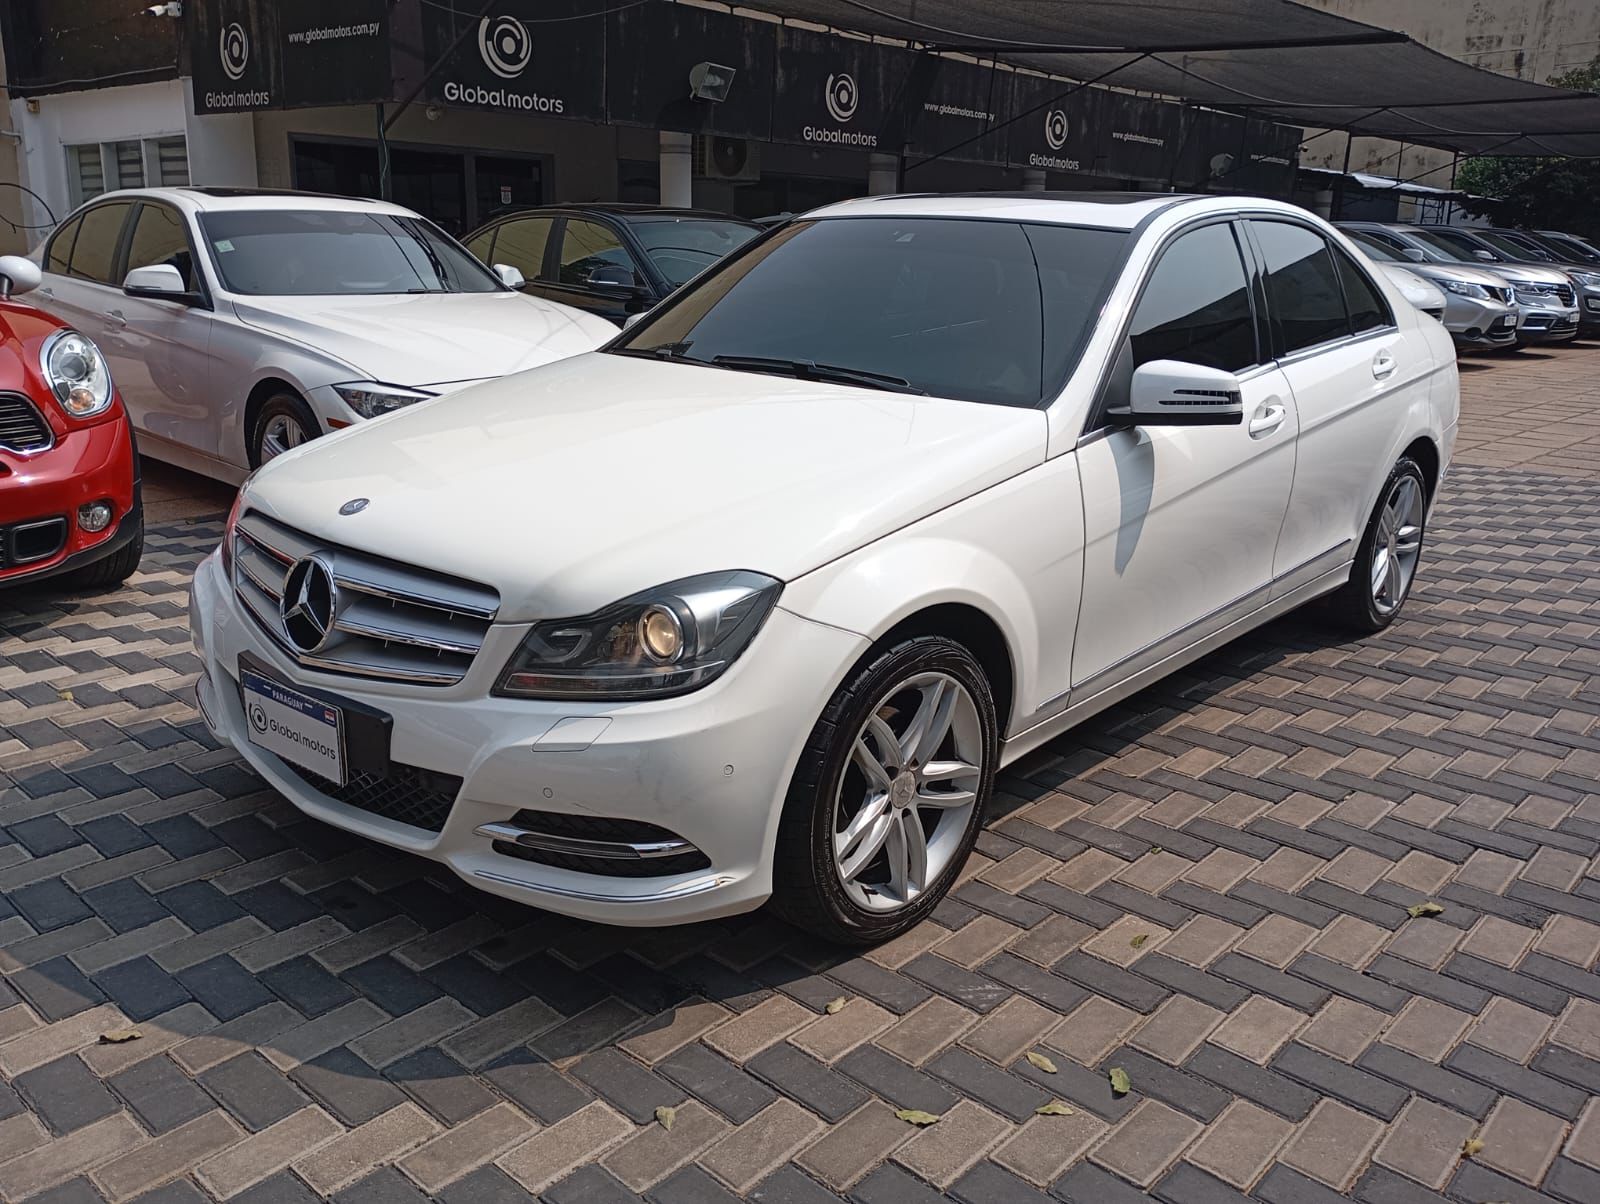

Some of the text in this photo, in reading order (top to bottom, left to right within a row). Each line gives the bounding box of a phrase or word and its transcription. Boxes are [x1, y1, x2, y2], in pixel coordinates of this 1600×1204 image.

[288, 21, 380, 44] www.globalmotors.com.py
[205, 90, 270, 108] Globalmotors
[443, 81, 564, 114] Globalmotors
[924, 103, 995, 122] www.globalmotors.compy
[802, 126, 877, 147] Globalmotors
[1029, 152, 1079, 170] Globalmotors
[272, 690, 304, 711] PARAGUAY
[269, 718, 336, 760] Globalmotors
